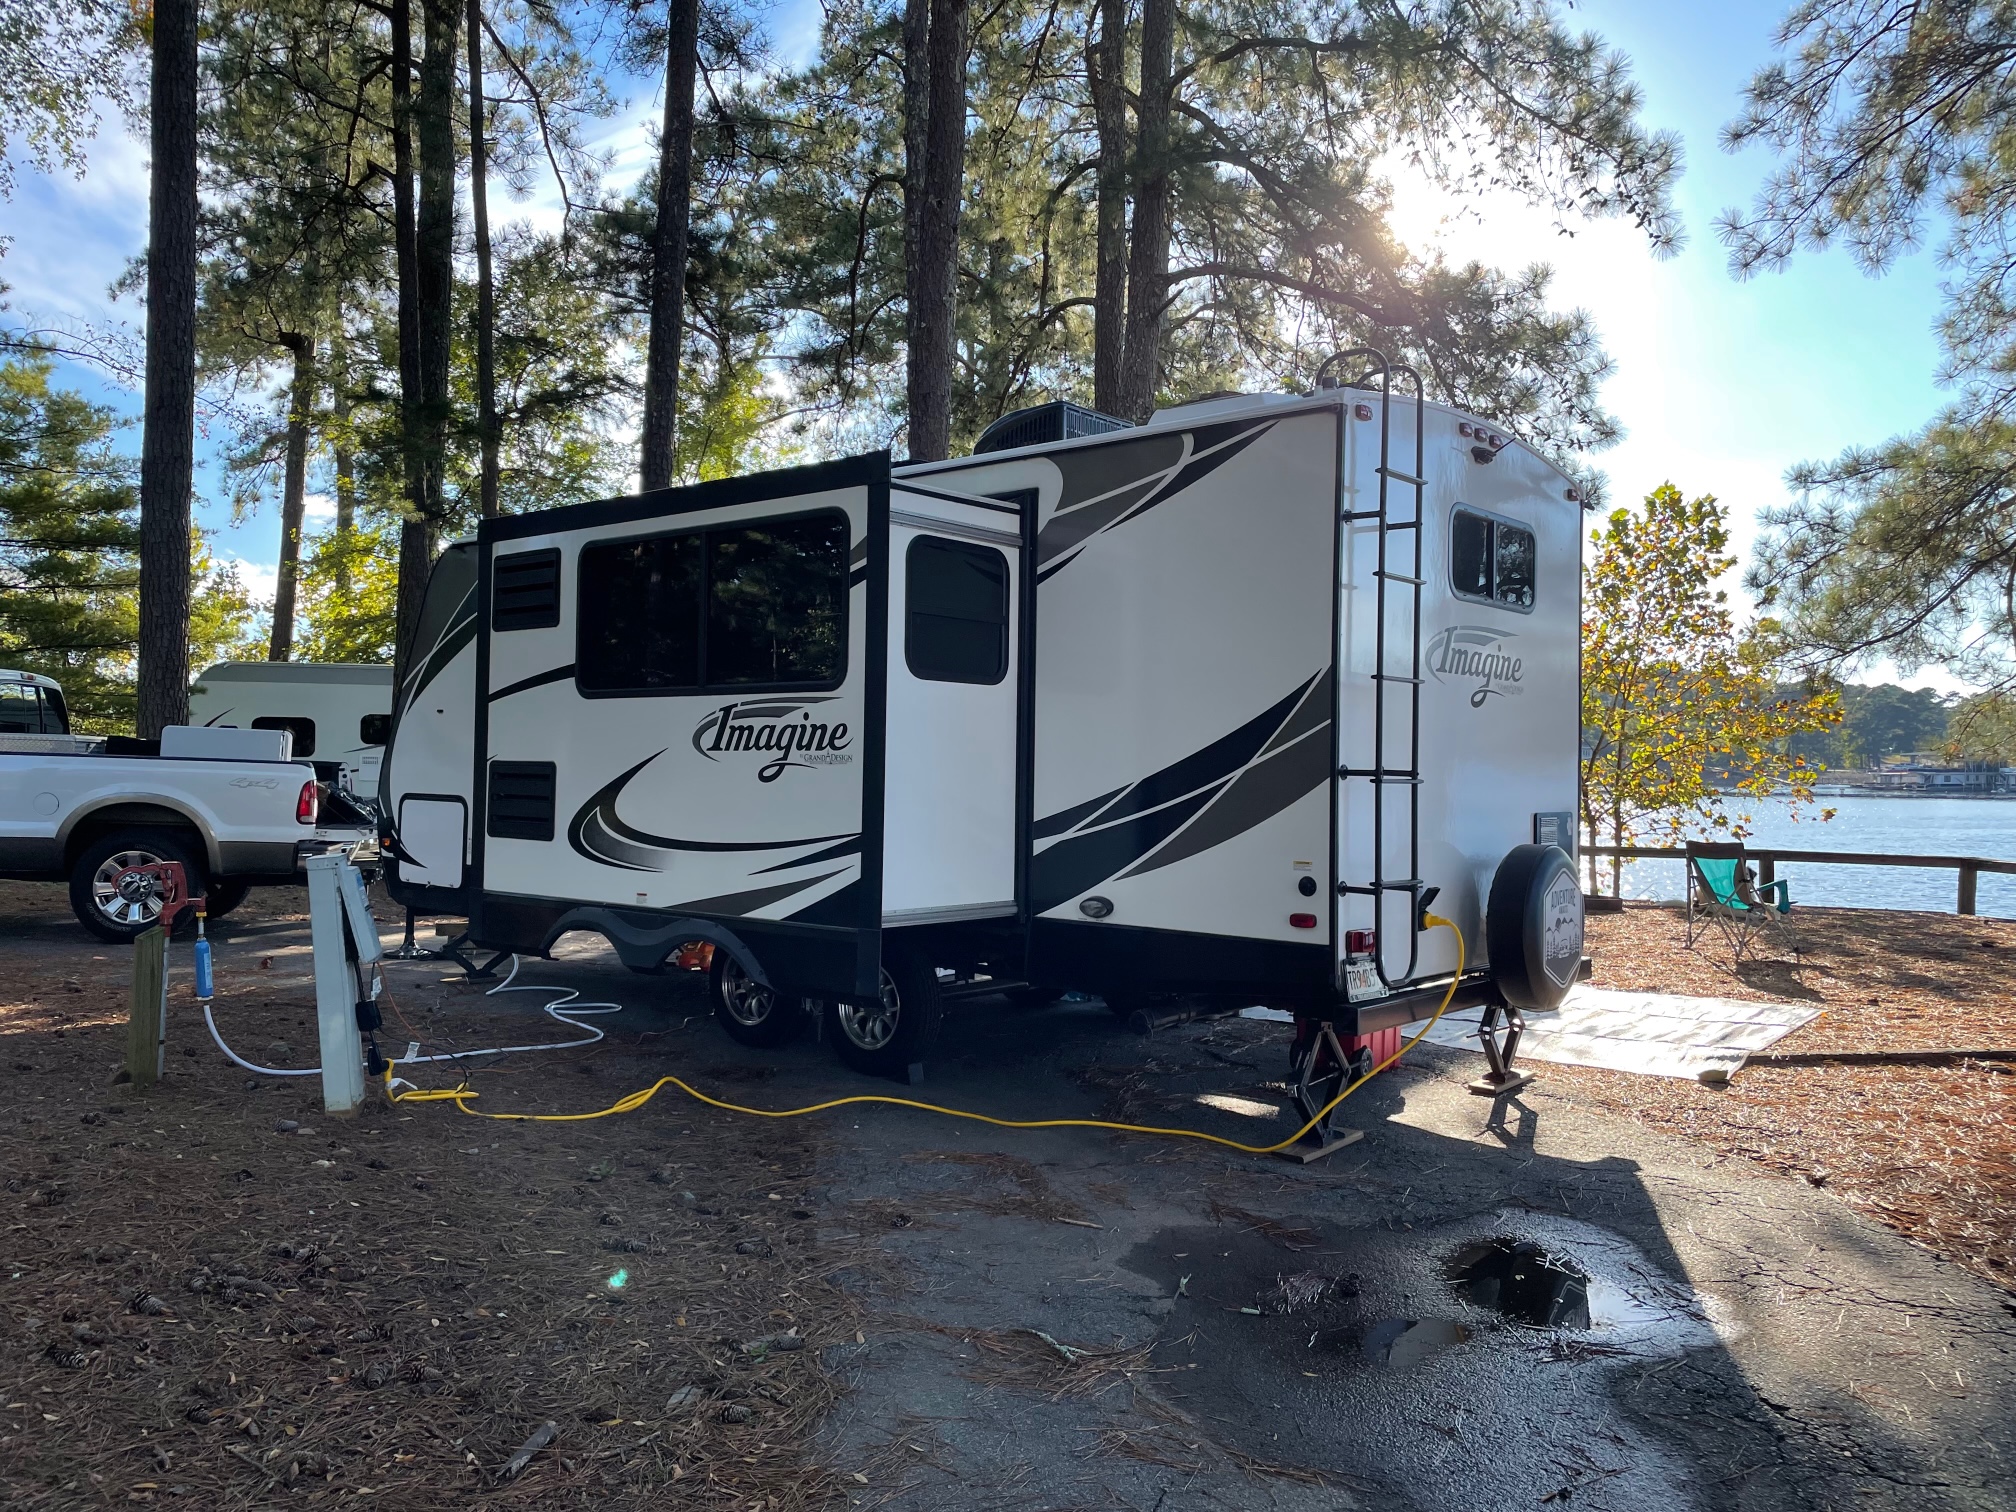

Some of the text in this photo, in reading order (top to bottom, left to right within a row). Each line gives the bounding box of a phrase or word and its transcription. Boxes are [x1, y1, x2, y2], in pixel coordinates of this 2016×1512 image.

[1435, 625, 1525, 709] Imagine
[706, 702, 855, 784] Imagine
[803, 753, 826, 762] GRAND
[830, 753, 853, 762] DESIGN
[1551, 887, 1576, 912] ADVENTURE
